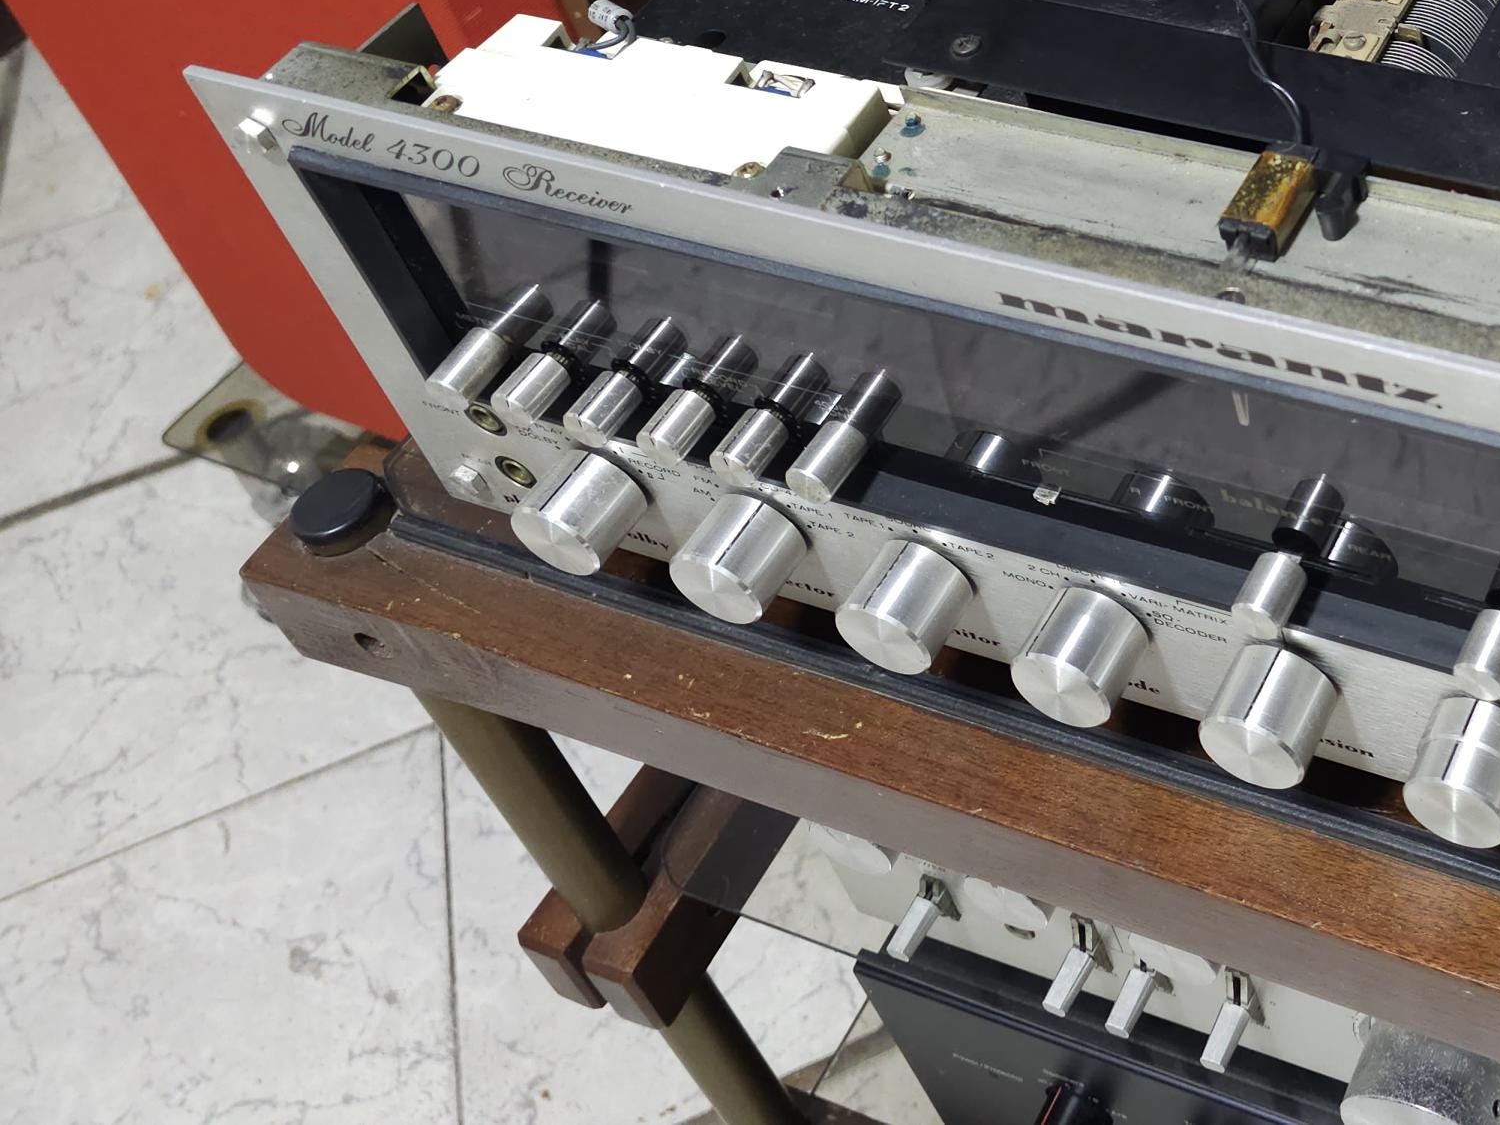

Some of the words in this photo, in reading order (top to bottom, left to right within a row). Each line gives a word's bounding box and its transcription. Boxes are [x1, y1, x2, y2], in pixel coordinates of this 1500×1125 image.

[281, 112, 376, 154] Model
[386, 139, 481, 179] 4300
[502, 163, 635, 216] Receiver
[996, 290, 1442, 408] marantz
[791, 502, 825, 517] TAPE
[809, 520, 842, 535] TAPE
[626, 531, 670, 552] olby
[785, 578, 836, 598] ector
[1002, 570, 1048, 588] MONO
[1171, 604, 1229, 626] MATRIX
[1153, 617, 1228, 644] DECODER
